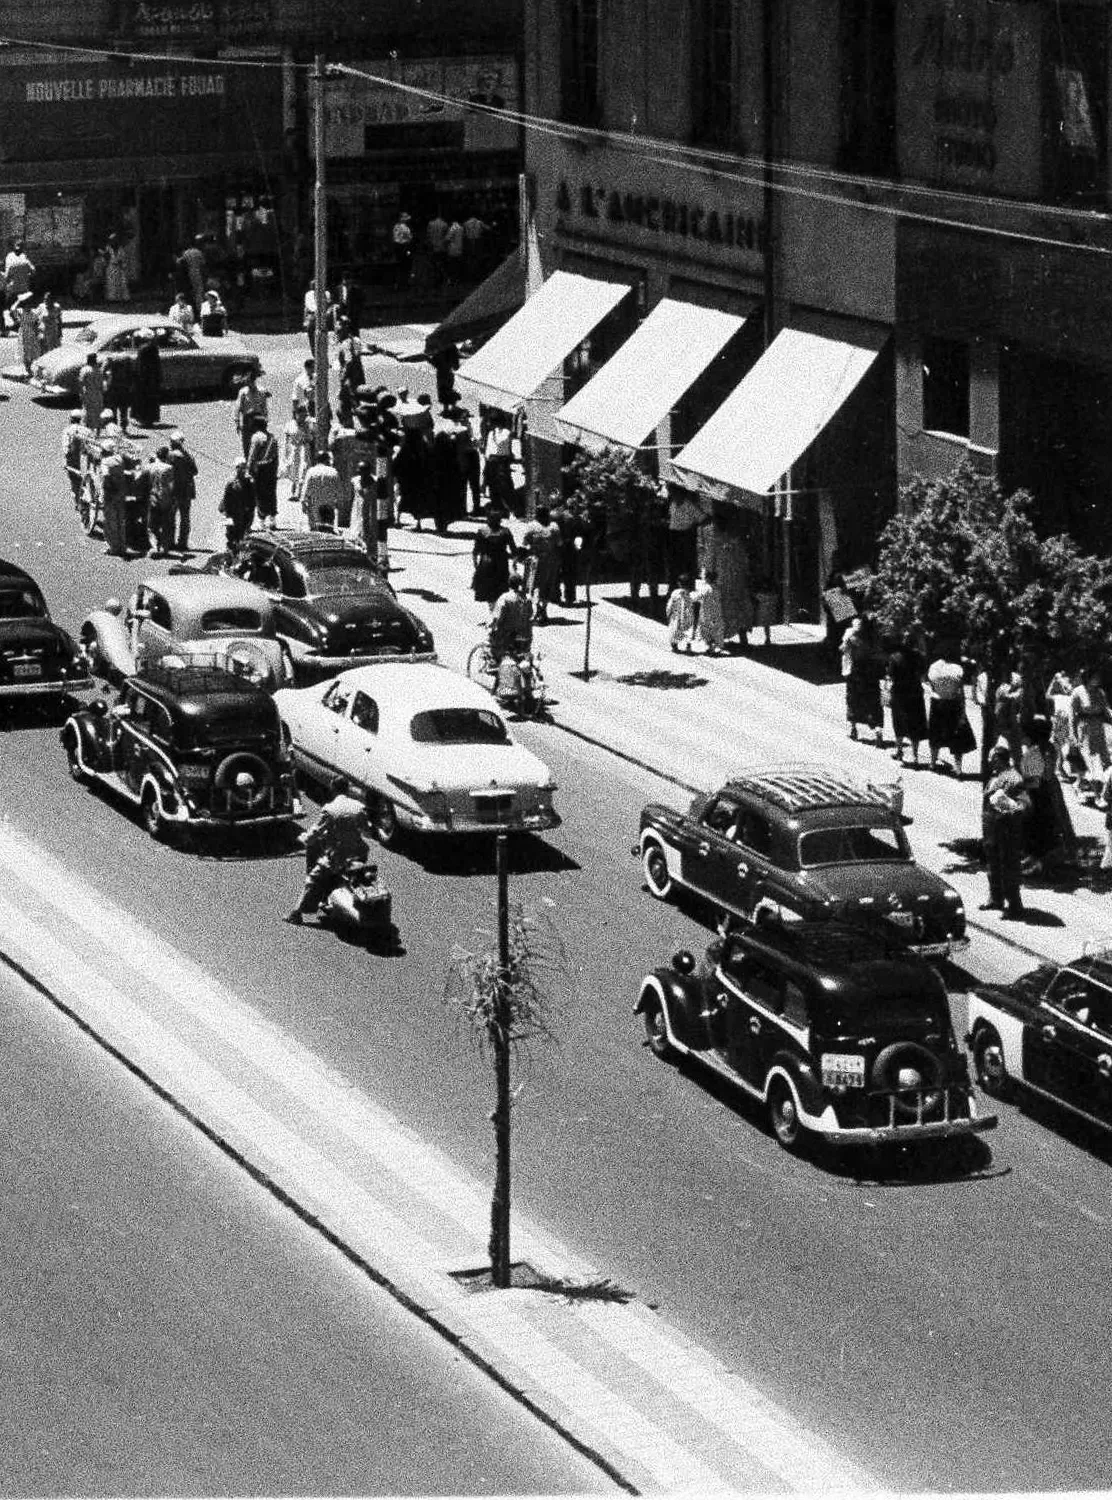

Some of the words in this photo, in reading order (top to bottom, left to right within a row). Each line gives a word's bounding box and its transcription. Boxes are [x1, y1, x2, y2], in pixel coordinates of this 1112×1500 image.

[26, 80, 94, 102] NOUVELLE
[98, 76, 176, 99] PHARMACIE
[181, 74, 226, 96] FOUAD
[555, 181, 571, 213] A
